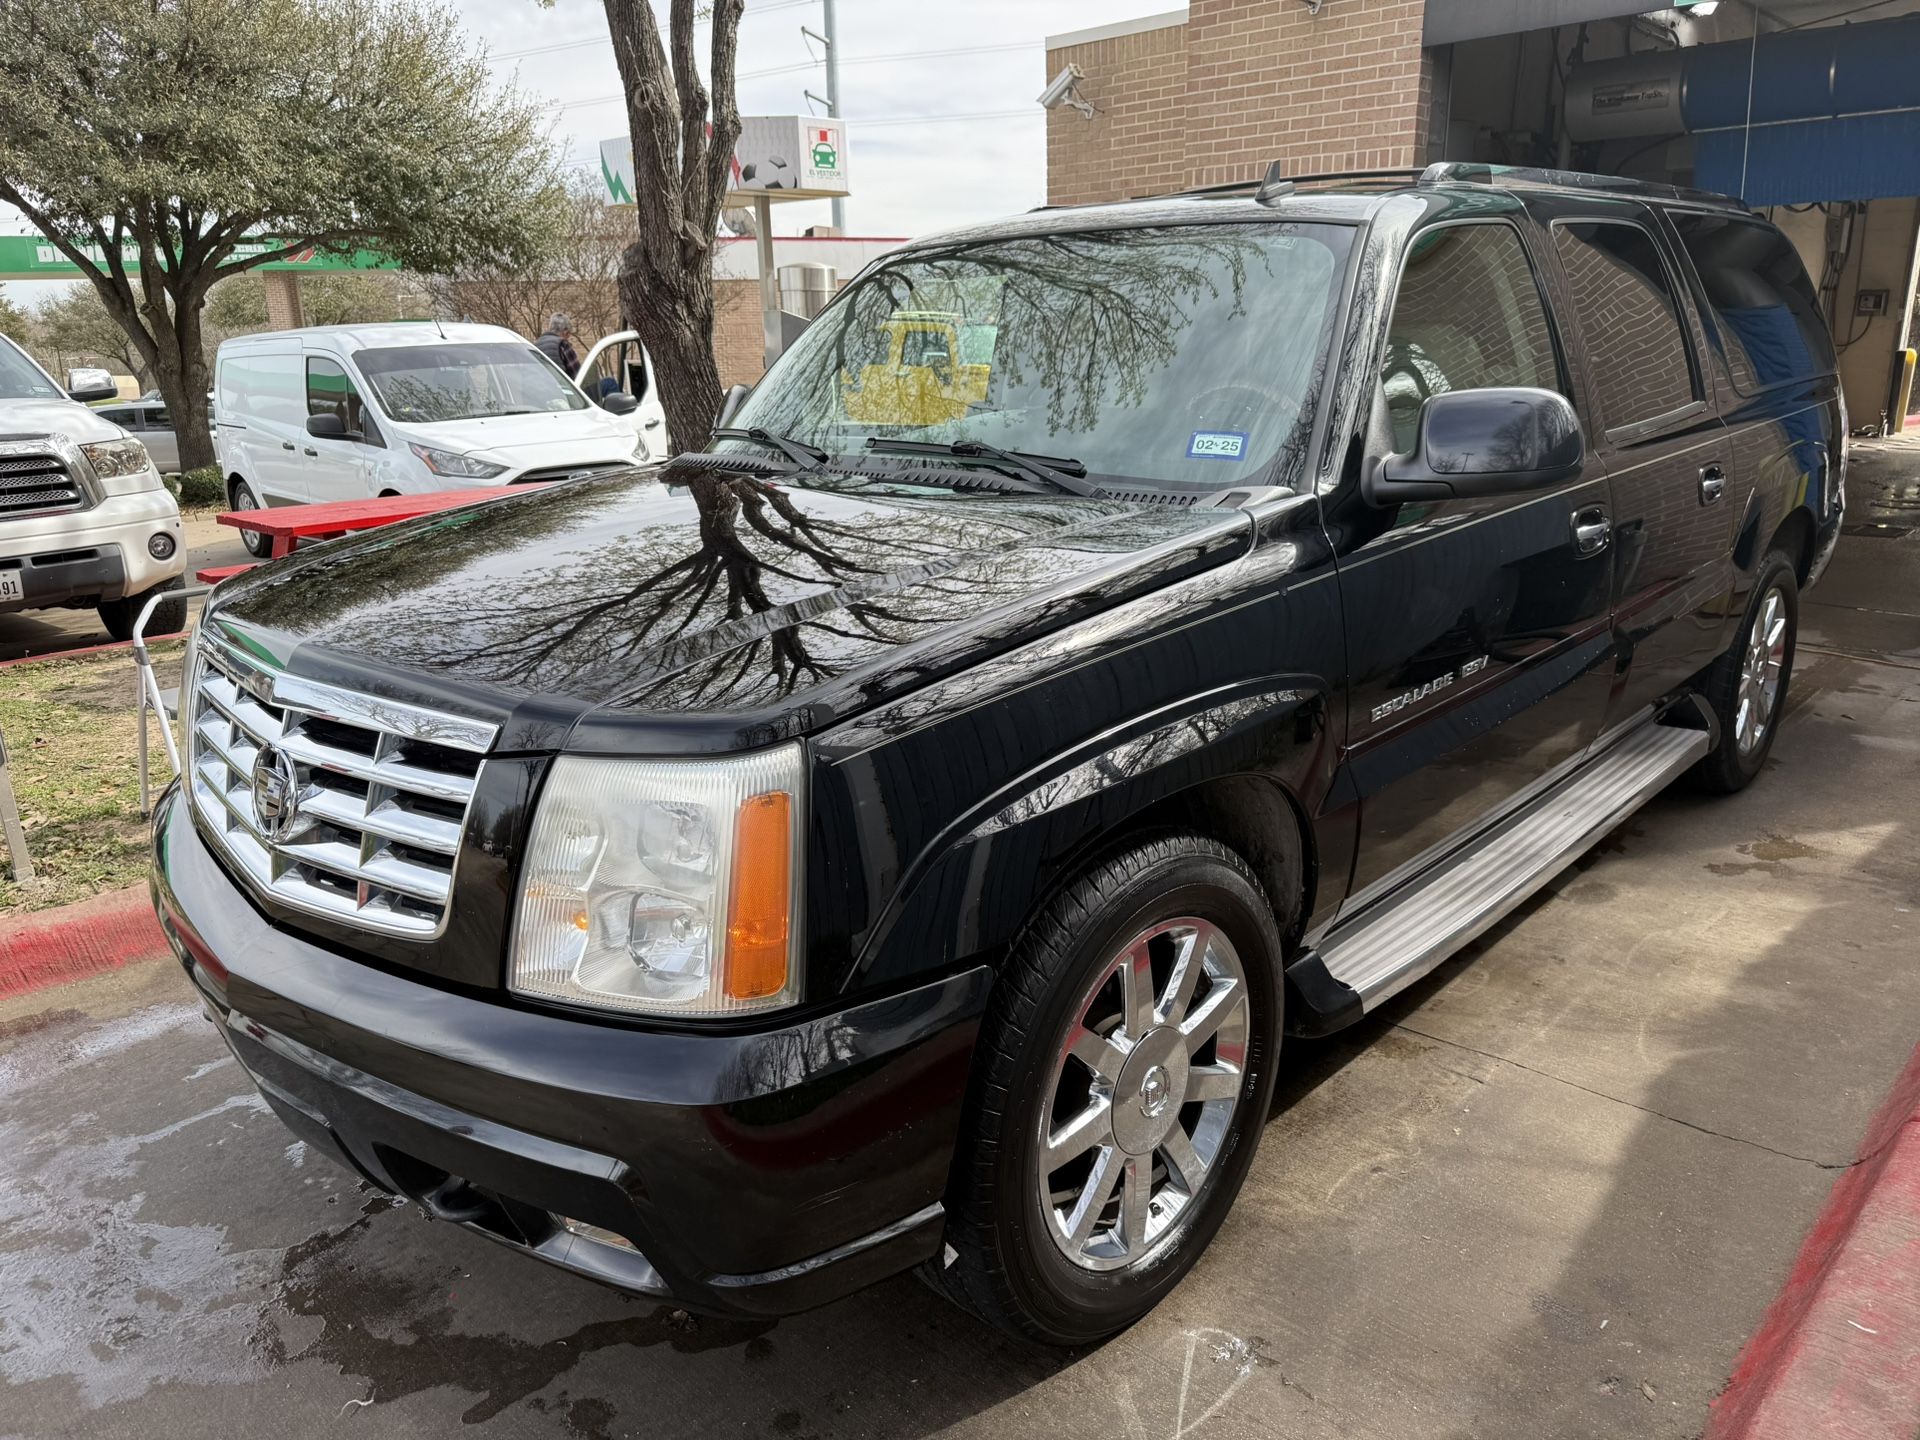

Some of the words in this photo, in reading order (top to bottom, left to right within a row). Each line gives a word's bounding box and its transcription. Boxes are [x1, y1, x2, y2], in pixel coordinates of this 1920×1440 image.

[0, 581, 18, 595] 91
[1371, 671, 1454, 723] ESCALADE
[1461, 654, 1489, 678] ESV
